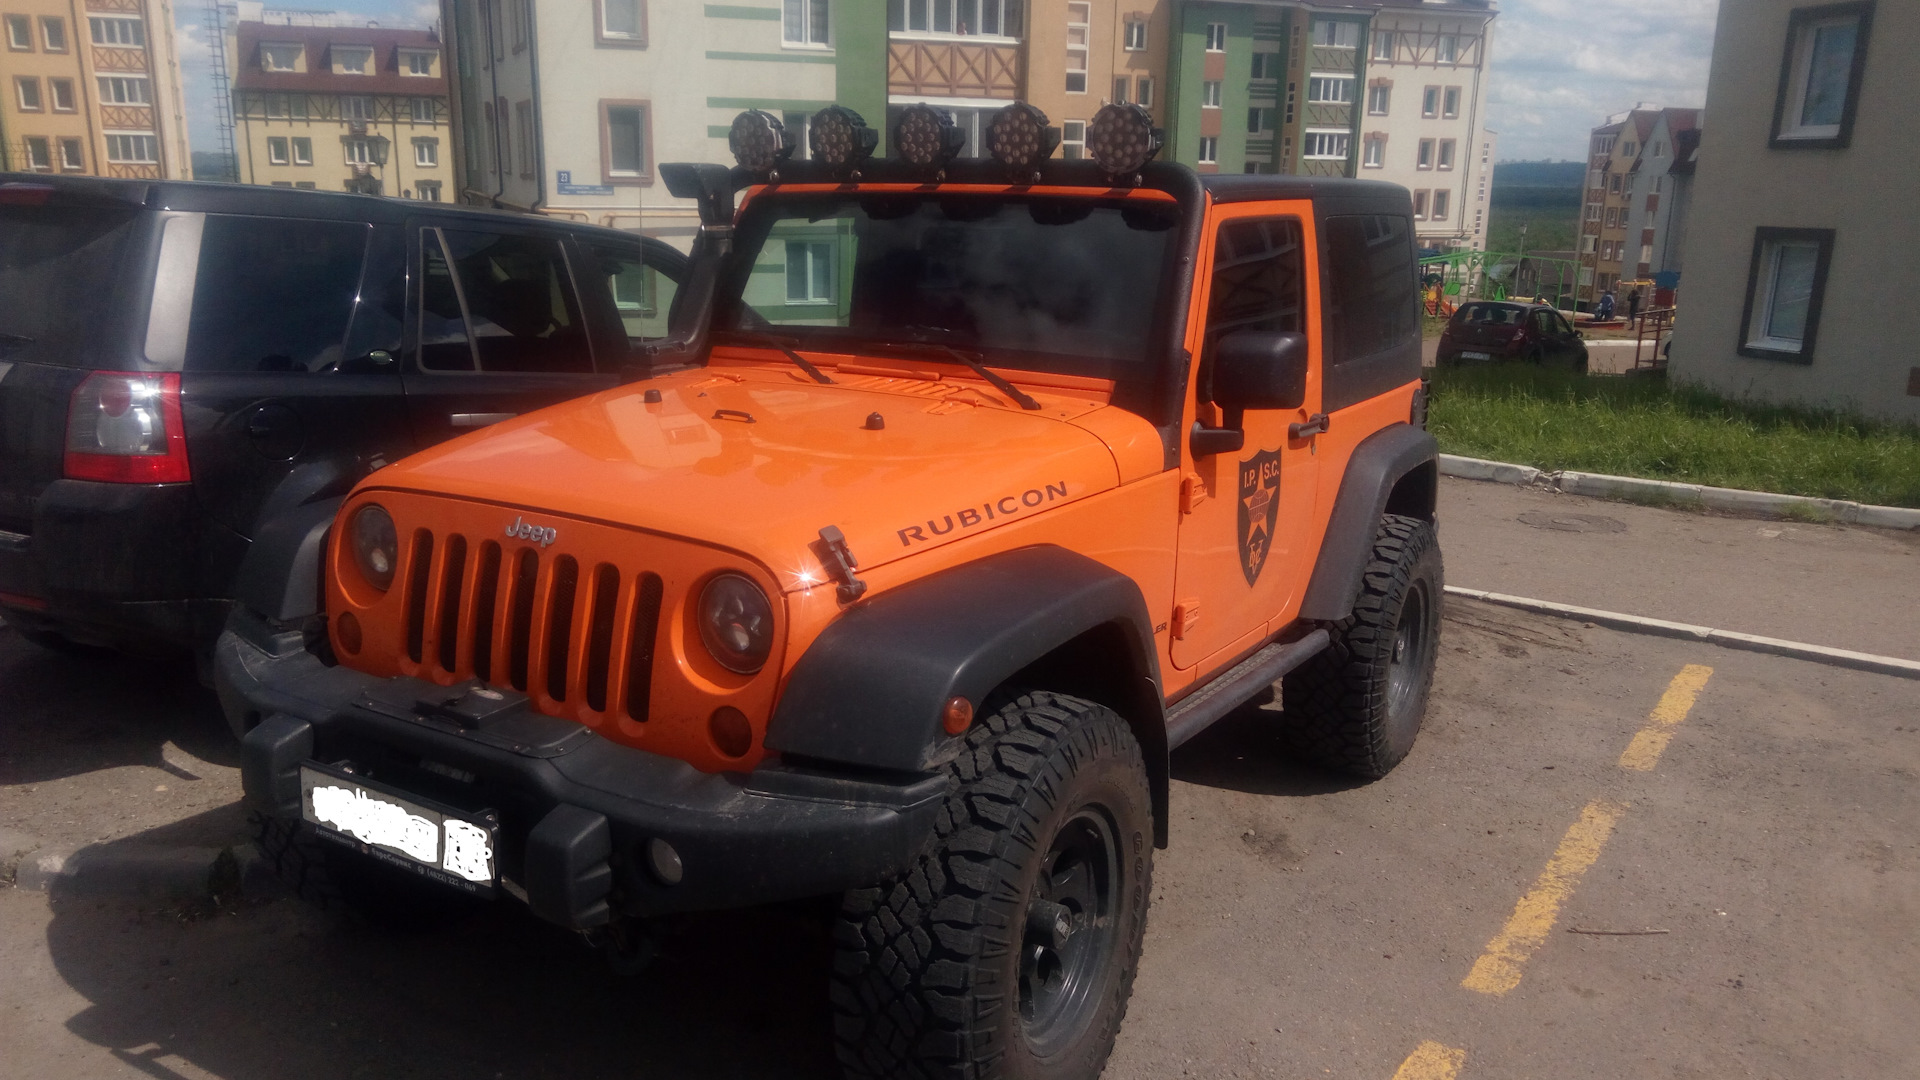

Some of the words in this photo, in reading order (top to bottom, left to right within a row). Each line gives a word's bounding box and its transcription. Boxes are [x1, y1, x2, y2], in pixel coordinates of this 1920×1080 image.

[560, 172, 568, 182] 23
[1244, 469, 1256, 488] I.P.
[1264, 460, 1279, 480] S.C.
[897, 481, 1068, 547] RUBICON
[505, 516, 557, 548] Jeep
[1154, 622, 1167, 635] ER
